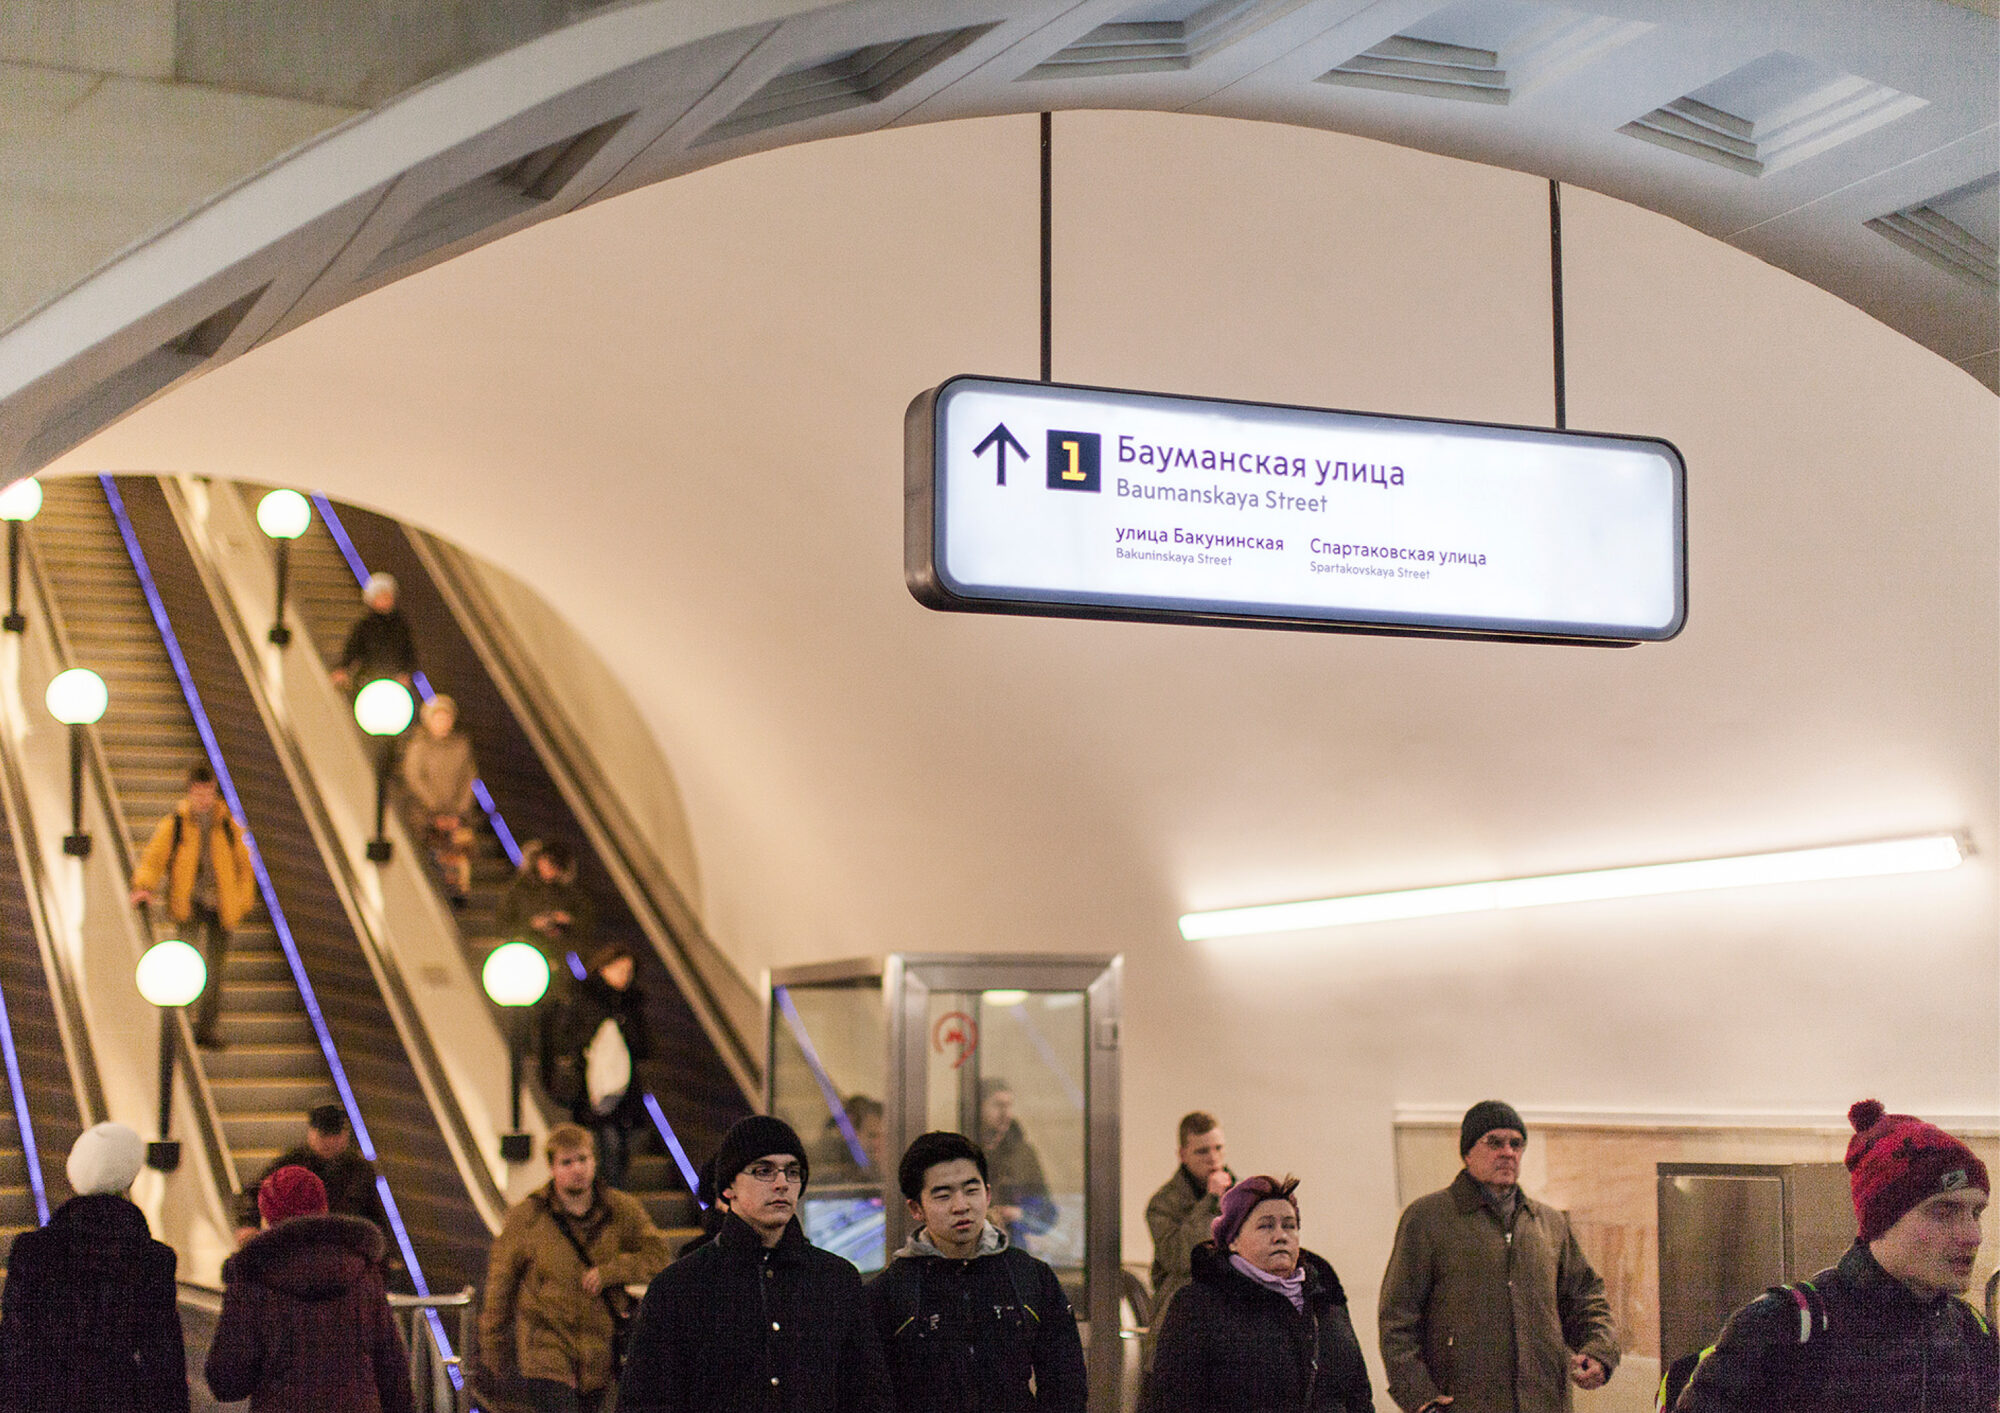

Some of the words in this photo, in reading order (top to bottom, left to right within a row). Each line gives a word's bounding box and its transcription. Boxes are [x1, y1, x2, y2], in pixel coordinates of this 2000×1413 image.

[1062, 441, 1087, 481] 1
[1118, 435, 1306, 477] Бауманская
[1314, 459, 1405, 489] улица
[1117, 478, 1259, 511] Baumanskaya
[1266, 490, 1328, 512] Street
[1115, 527, 1169, 545] улица
[1174, 528, 1284, 551] Бакунинская
[1310, 538, 1435, 563] Спартаковская
[1438, 551, 1487, 567] улица
[1116, 547, 1195, 565] Bakuninskaya
[1197, 553, 1232, 566] Street
[1310, 561, 1395, 579] Spartakovskaya
[1397, 566, 1431, 580] Street
